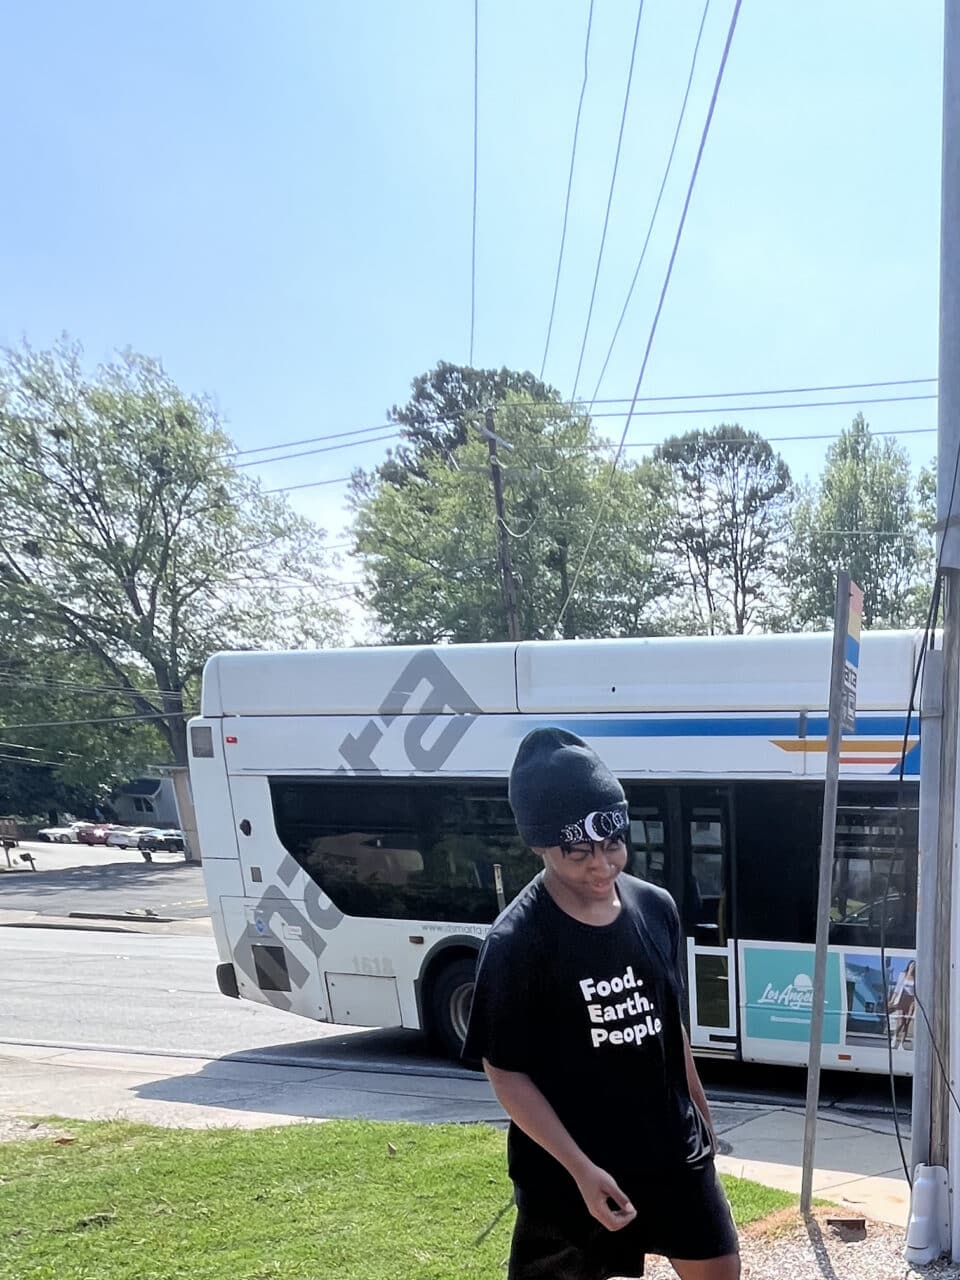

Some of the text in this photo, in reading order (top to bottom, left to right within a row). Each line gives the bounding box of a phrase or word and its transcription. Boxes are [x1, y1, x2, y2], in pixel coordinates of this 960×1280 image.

[579, 965, 644, 1001] Food.
[757, 982, 814, 1010] Los Angel
[587, 991, 655, 1023] Earth.
